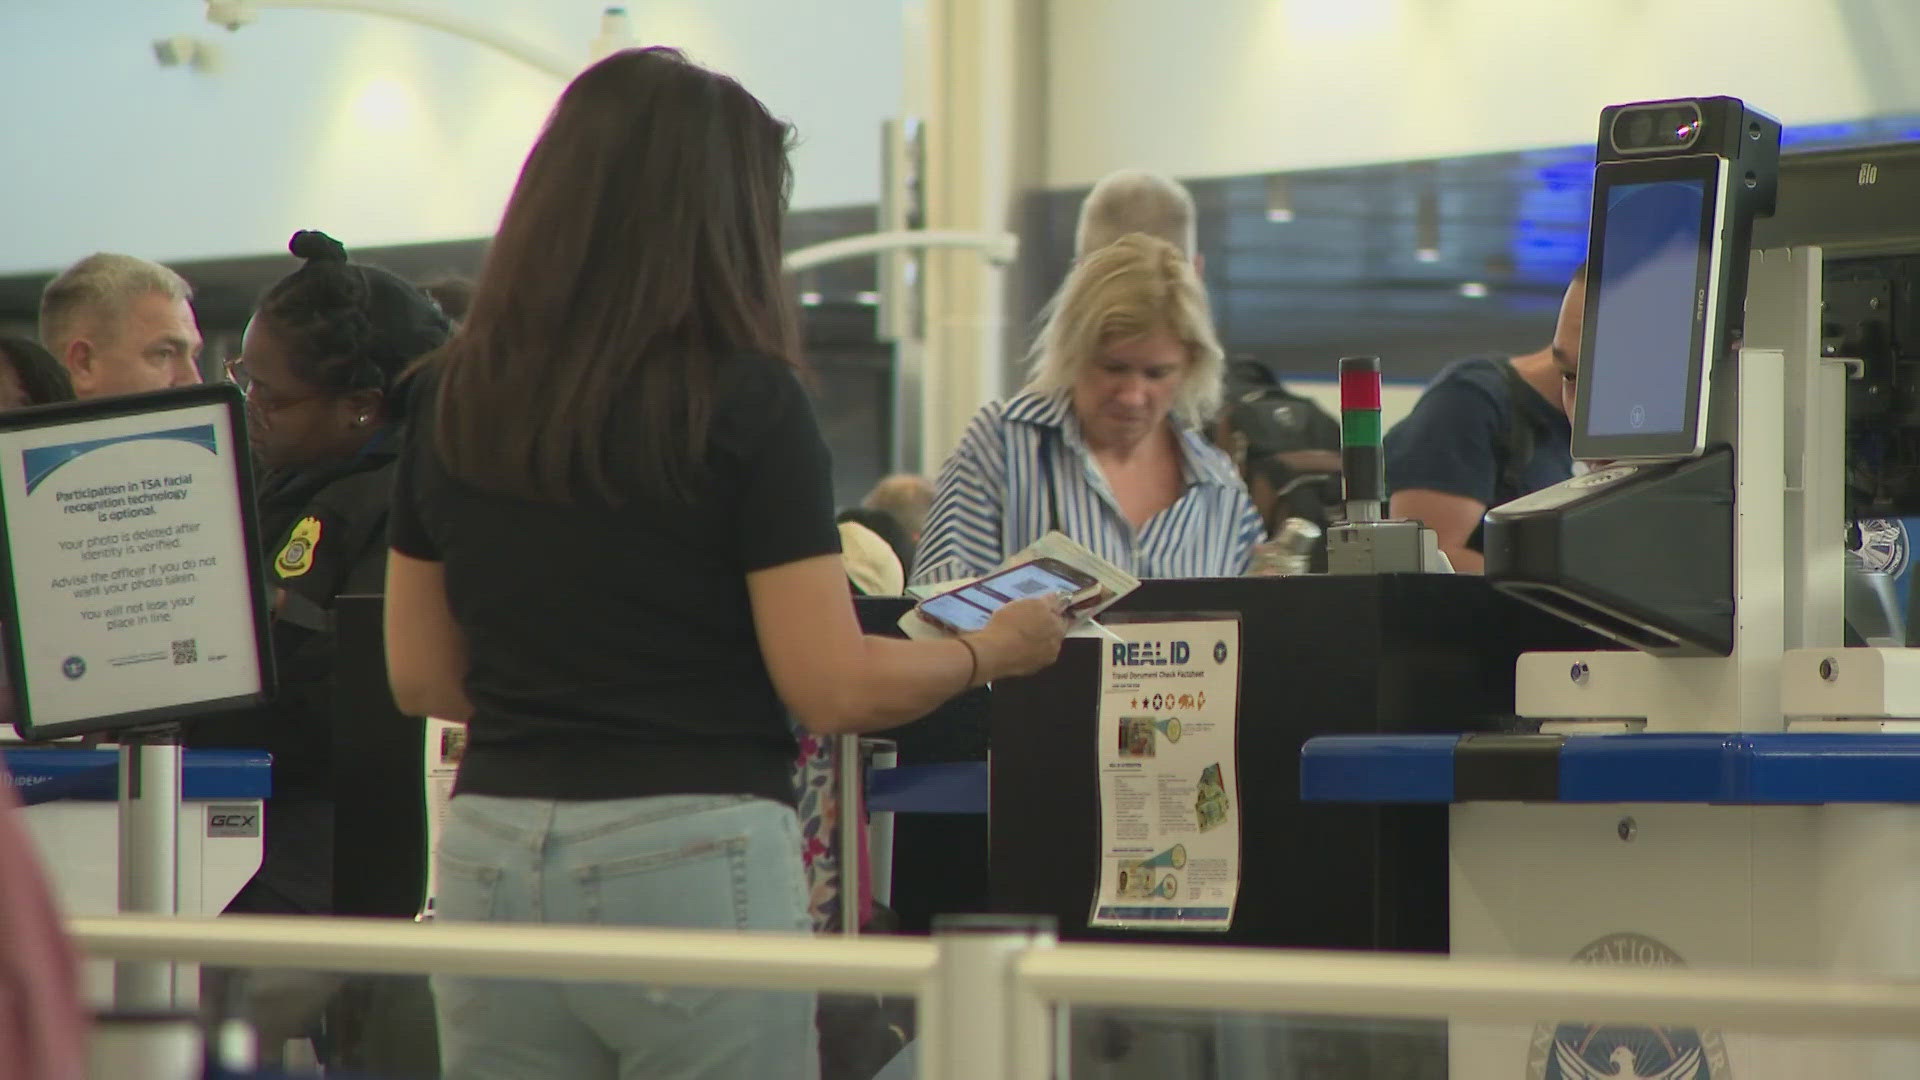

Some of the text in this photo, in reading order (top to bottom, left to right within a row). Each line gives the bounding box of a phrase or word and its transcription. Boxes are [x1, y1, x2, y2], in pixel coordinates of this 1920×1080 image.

[56, 473, 193, 502] Participation in TSA facial
[64, 489, 188, 514] recognition technology
[98, 505, 156, 522] is optional.
[58, 522, 201, 551] Your photo is deleted after
[81, 544, 123, 562] identity
[125, 543, 135, 554] is
[51, 556, 217, 589] Advise the officer if you do not
[73, 586, 101, 599] want
[104, 581, 129, 595] your
[131, 576, 163, 591] photo
[80, 595, 196, 621] You will not lose your
[106, 616, 135, 631] place
[137, 613, 149, 625] in
[1112, 641, 1190, 666] REAL ID
[1112, 670, 1205, 680] Travel Document Check Factsheet
[211, 815, 255, 827] GCX
